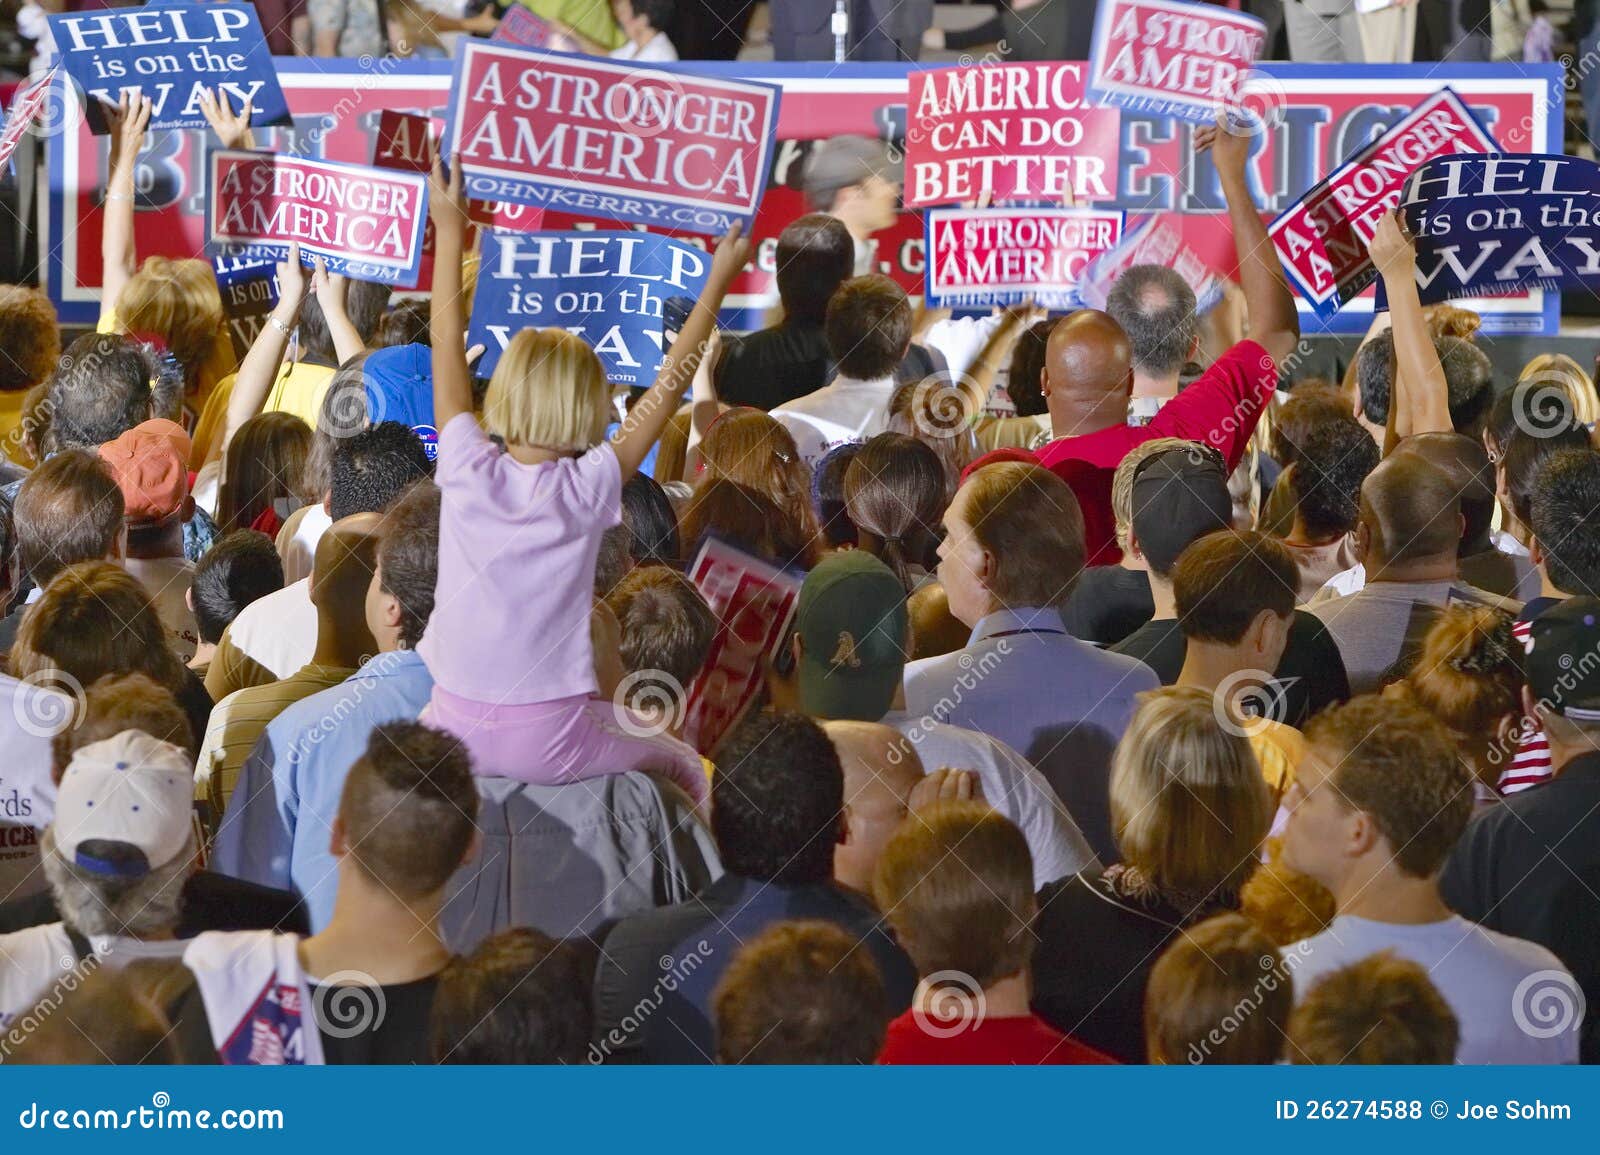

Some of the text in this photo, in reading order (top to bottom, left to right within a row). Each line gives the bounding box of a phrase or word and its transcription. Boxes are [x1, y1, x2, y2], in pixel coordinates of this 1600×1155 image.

[58, 8, 249, 53] HELP
[1111, 5, 1141, 43] A
[93, 45, 248, 79] is on the
[472, 61, 507, 106] A
[514, 68, 758, 145] STRONGER
[464, 110, 752, 200] AMERICA
[931, 116, 1085, 153] CAN DO
[220, 161, 410, 220] A STRONGER
[911, 155, 1110, 203] BETTER
[1303, 109, 1467, 238] STRONGER
[1401, 157, 1600, 210] HEL
[218, 198, 408, 258] AMERICA
[938, 217, 1115, 252] A STRONGER
[1415, 208, 1452, 238] is
[1466, 206, 1525, 232] on
[491, 235, 704, 290] HELP
[1284, 226, 1313, 262] A
[937, 248, 1104, 285] AMERIC
[226, 278, 247, 305] is
[249, 280, 273, 301] on
[507, 283, 664, 318] is on th
